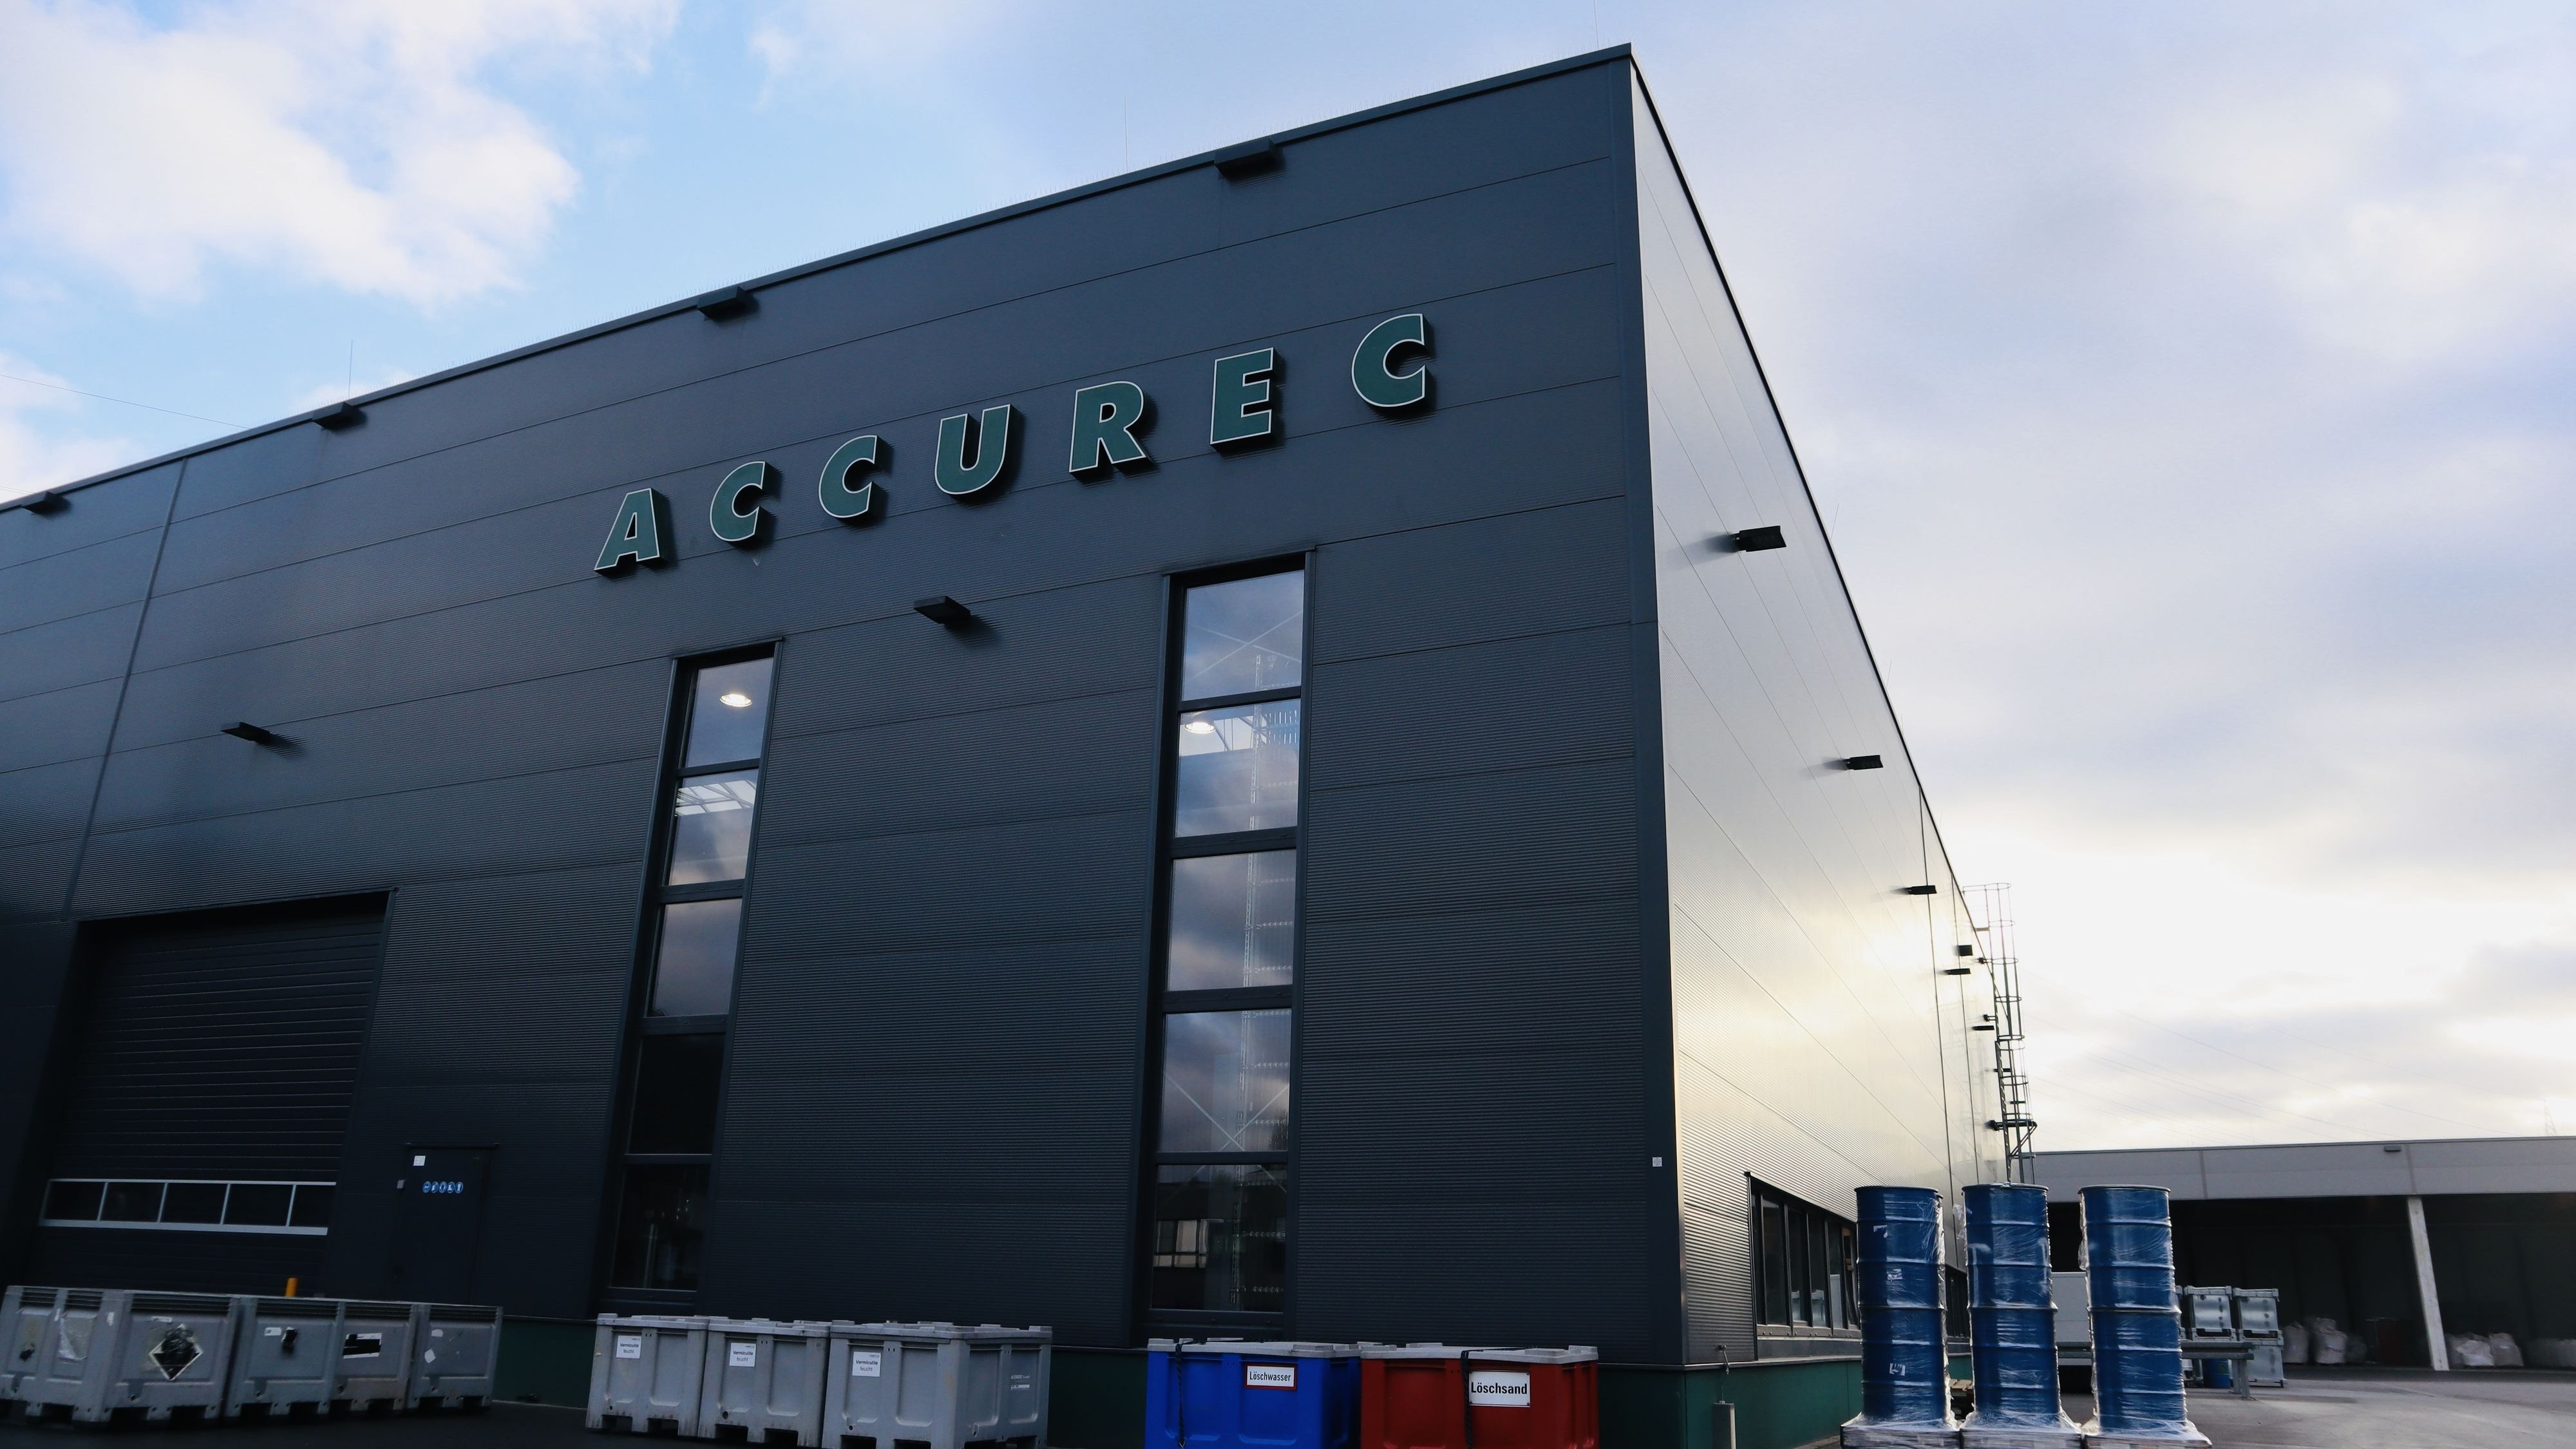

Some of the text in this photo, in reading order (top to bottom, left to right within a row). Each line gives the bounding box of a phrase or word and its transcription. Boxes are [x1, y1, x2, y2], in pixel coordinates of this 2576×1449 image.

[594, 313, 1425, 571] ACCUREC
[1249, 1371, 1291, 1381] Löschwasser
[1471, 1381, 1528, 1394] Löschsand
